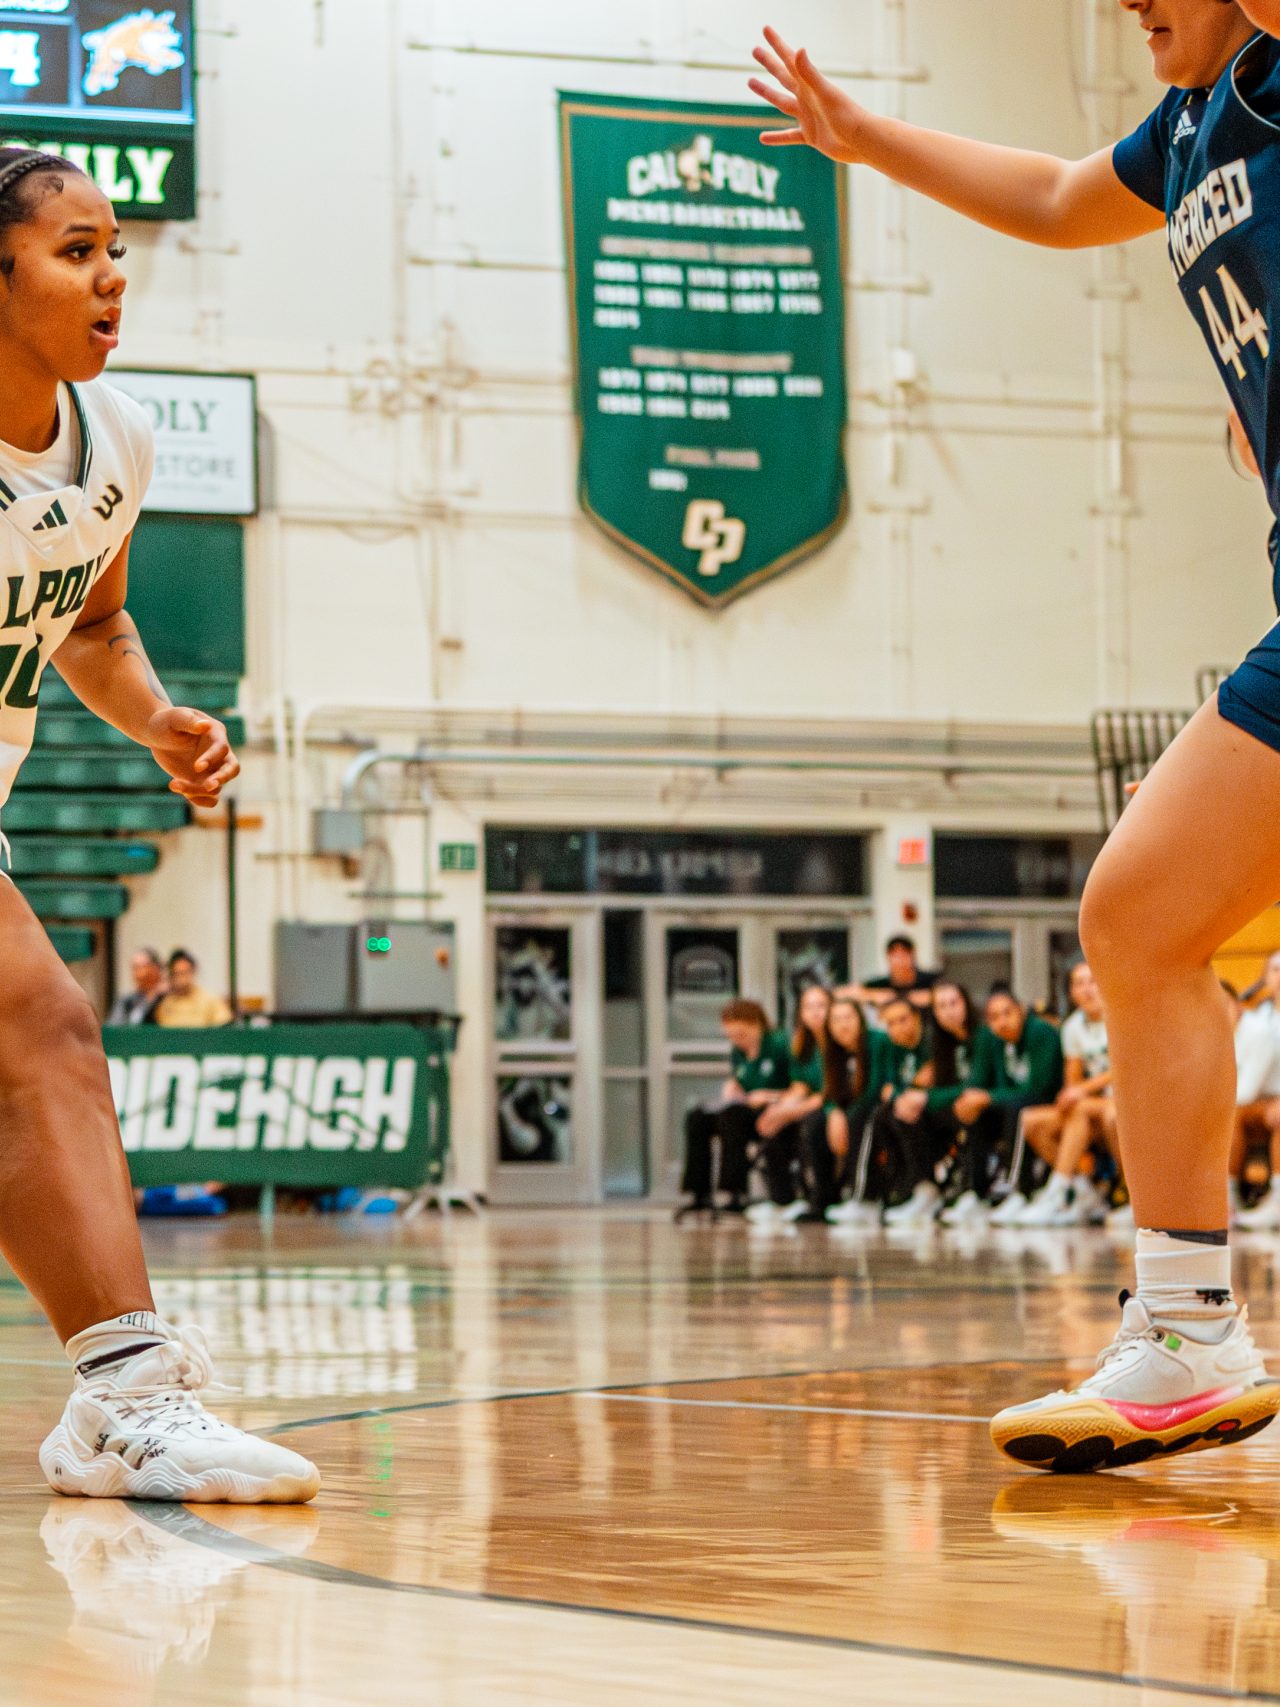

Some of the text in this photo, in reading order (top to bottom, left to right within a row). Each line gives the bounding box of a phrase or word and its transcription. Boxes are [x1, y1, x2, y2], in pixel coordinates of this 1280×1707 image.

[627, 150, 780, 203] CAL POLY
[1167, 158, 1253, 283] MERCED
[1198, 264, 1269, 380] 44
[140, 395, 218, 432] OLY
